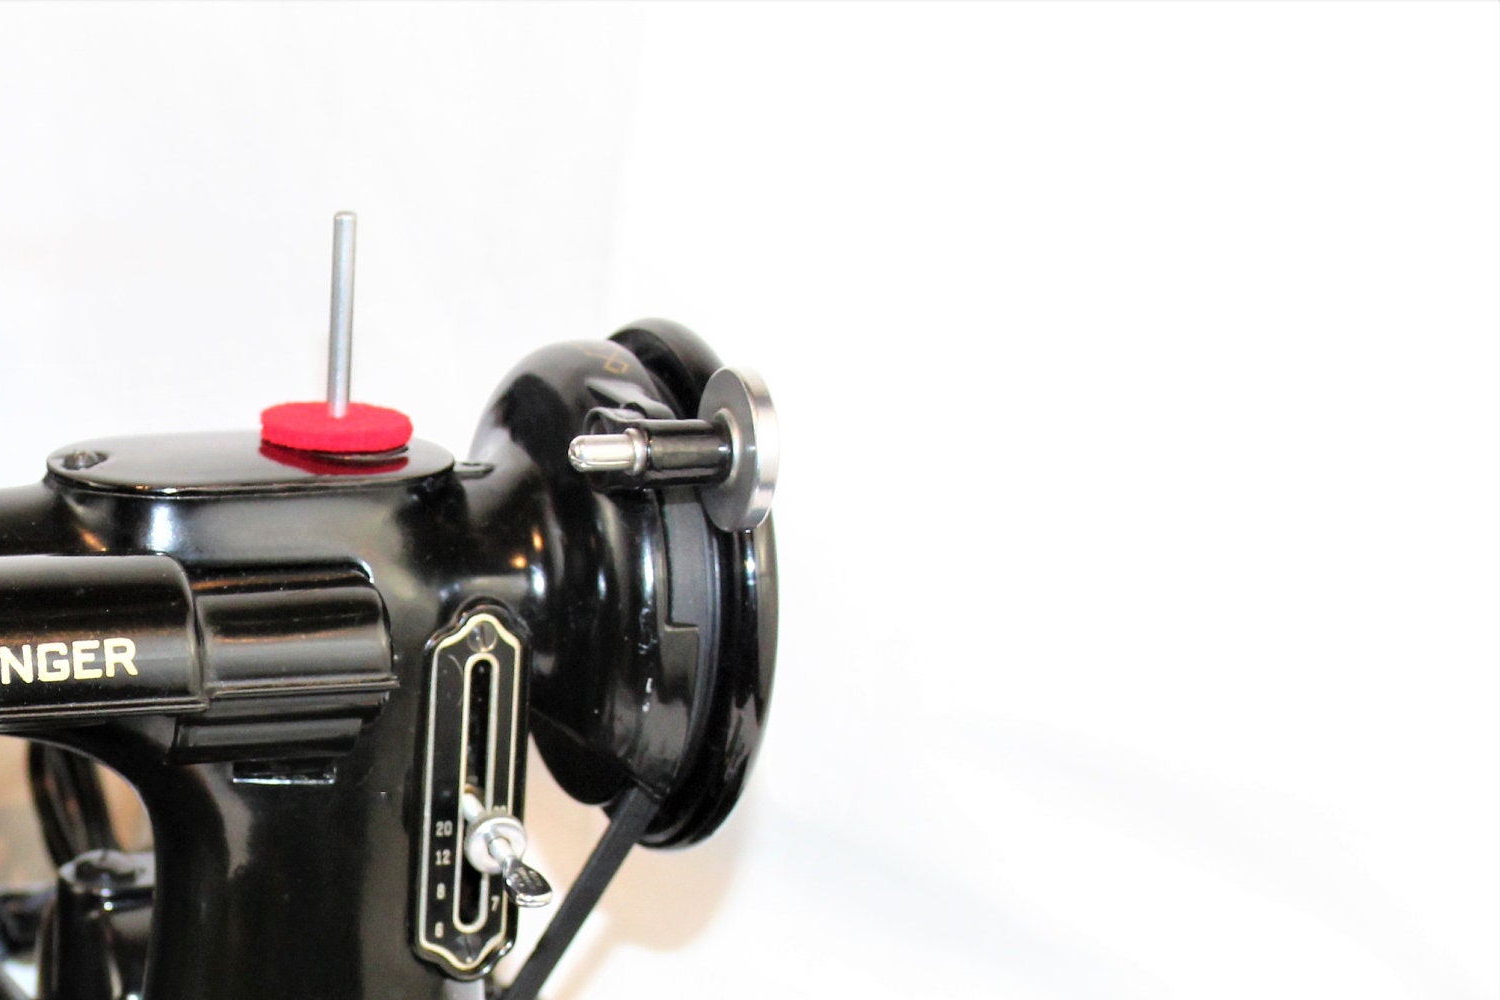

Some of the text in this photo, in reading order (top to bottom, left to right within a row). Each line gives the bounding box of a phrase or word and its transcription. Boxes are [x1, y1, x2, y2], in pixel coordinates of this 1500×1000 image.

[435, 820, 453, 837] 20
[435, 848, 451, 866] 12
[491, 895, 500, 912] 7
